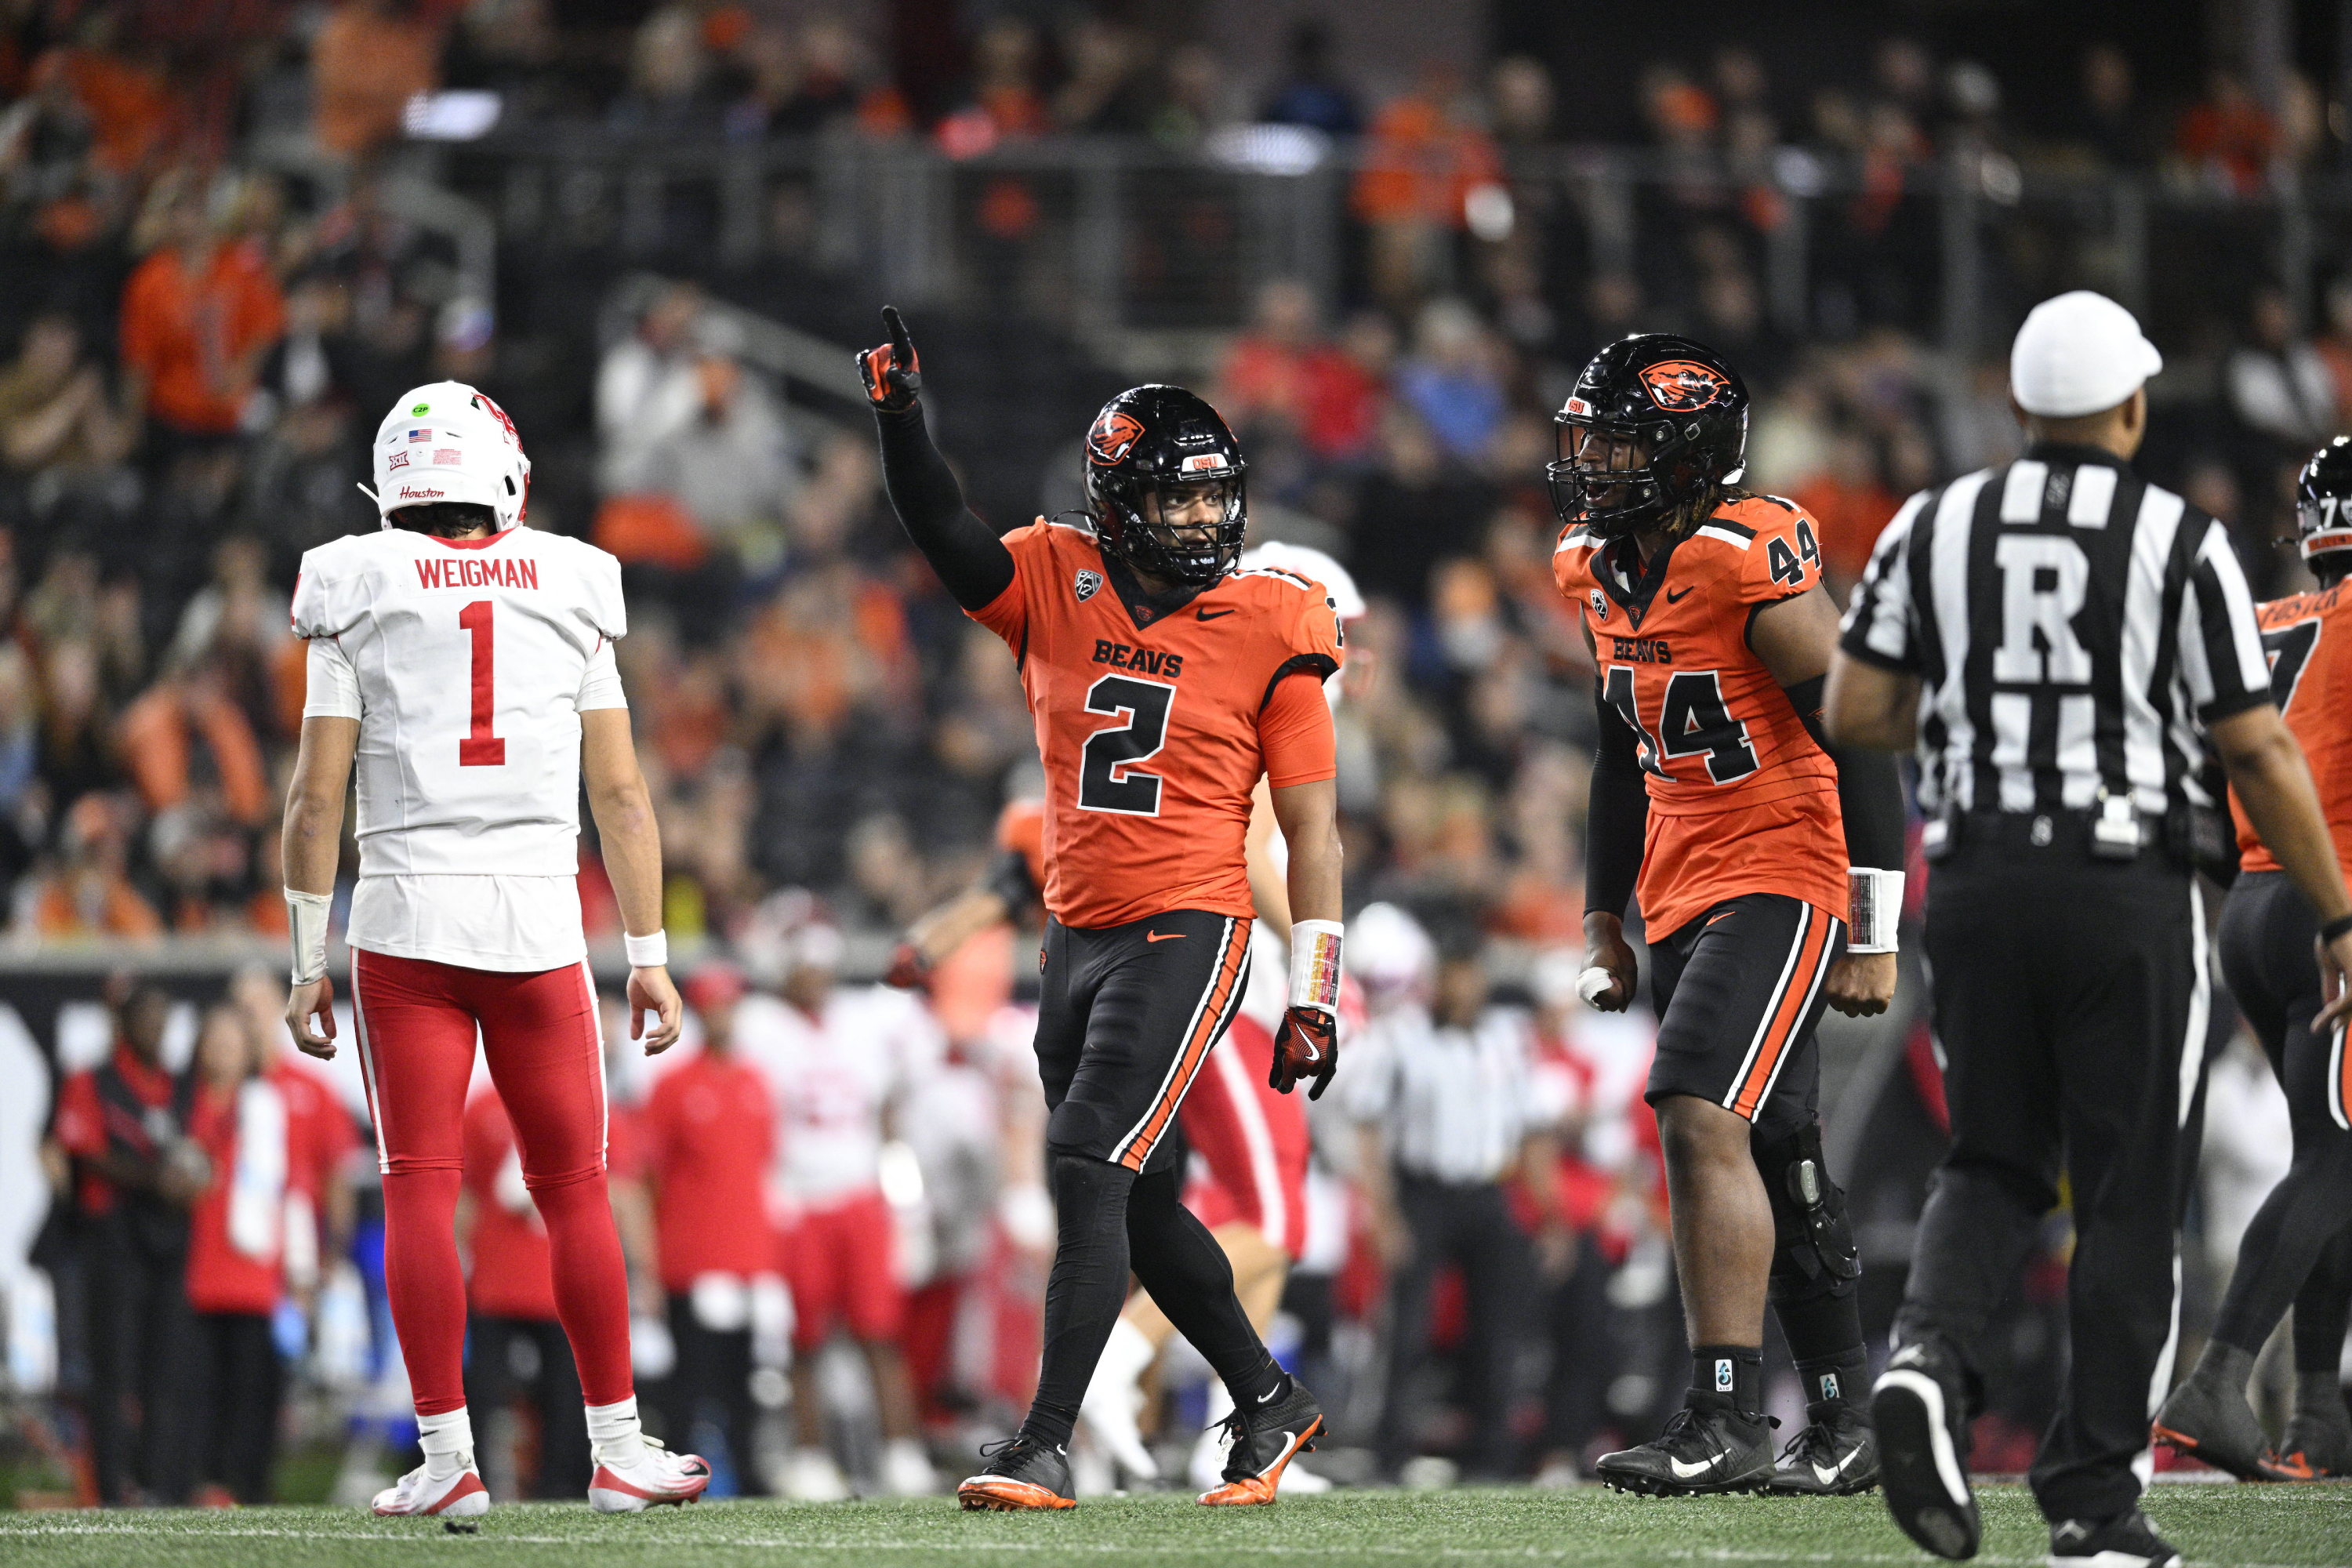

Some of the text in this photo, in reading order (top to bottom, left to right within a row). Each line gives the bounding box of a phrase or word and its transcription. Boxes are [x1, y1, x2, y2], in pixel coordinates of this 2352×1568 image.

[1192, 456, 1218, 470] OSU
[400, 486, 445, 499] Houston
[1766, 518, 1821, 587] 44
[415, 558, 539, 590] WEIGMAN
[1078, 583, 1093, 597] 12
[1994, 533, 2092, 684] R
[1092, 638, 1184, 678] BEAVS
[1613, 637, 1672, 664] BEAVS
[459, 601, 506, 766] 1
[1076, 672, 1177, 818] 2
